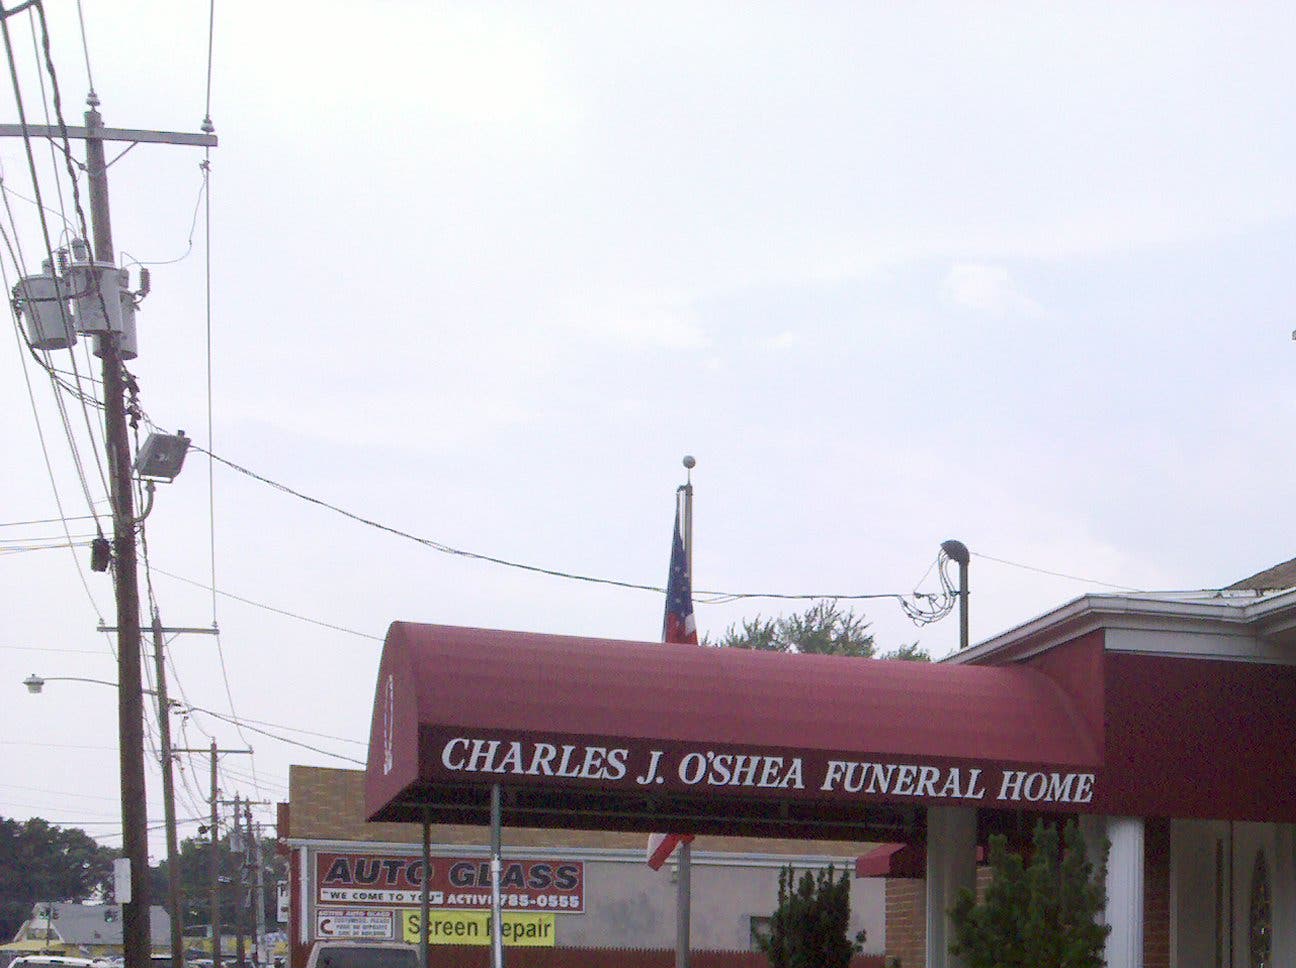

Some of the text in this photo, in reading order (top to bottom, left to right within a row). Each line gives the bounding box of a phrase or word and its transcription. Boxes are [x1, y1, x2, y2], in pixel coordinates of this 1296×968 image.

[441, 737, 1097, 803] CHARLES J. O'SHEA FUNERAL HOME
[322, 857, 580, 890] AUTO GLASS
[352, 892, 384, 901] COME
[389, 893, 404, 901] TO
